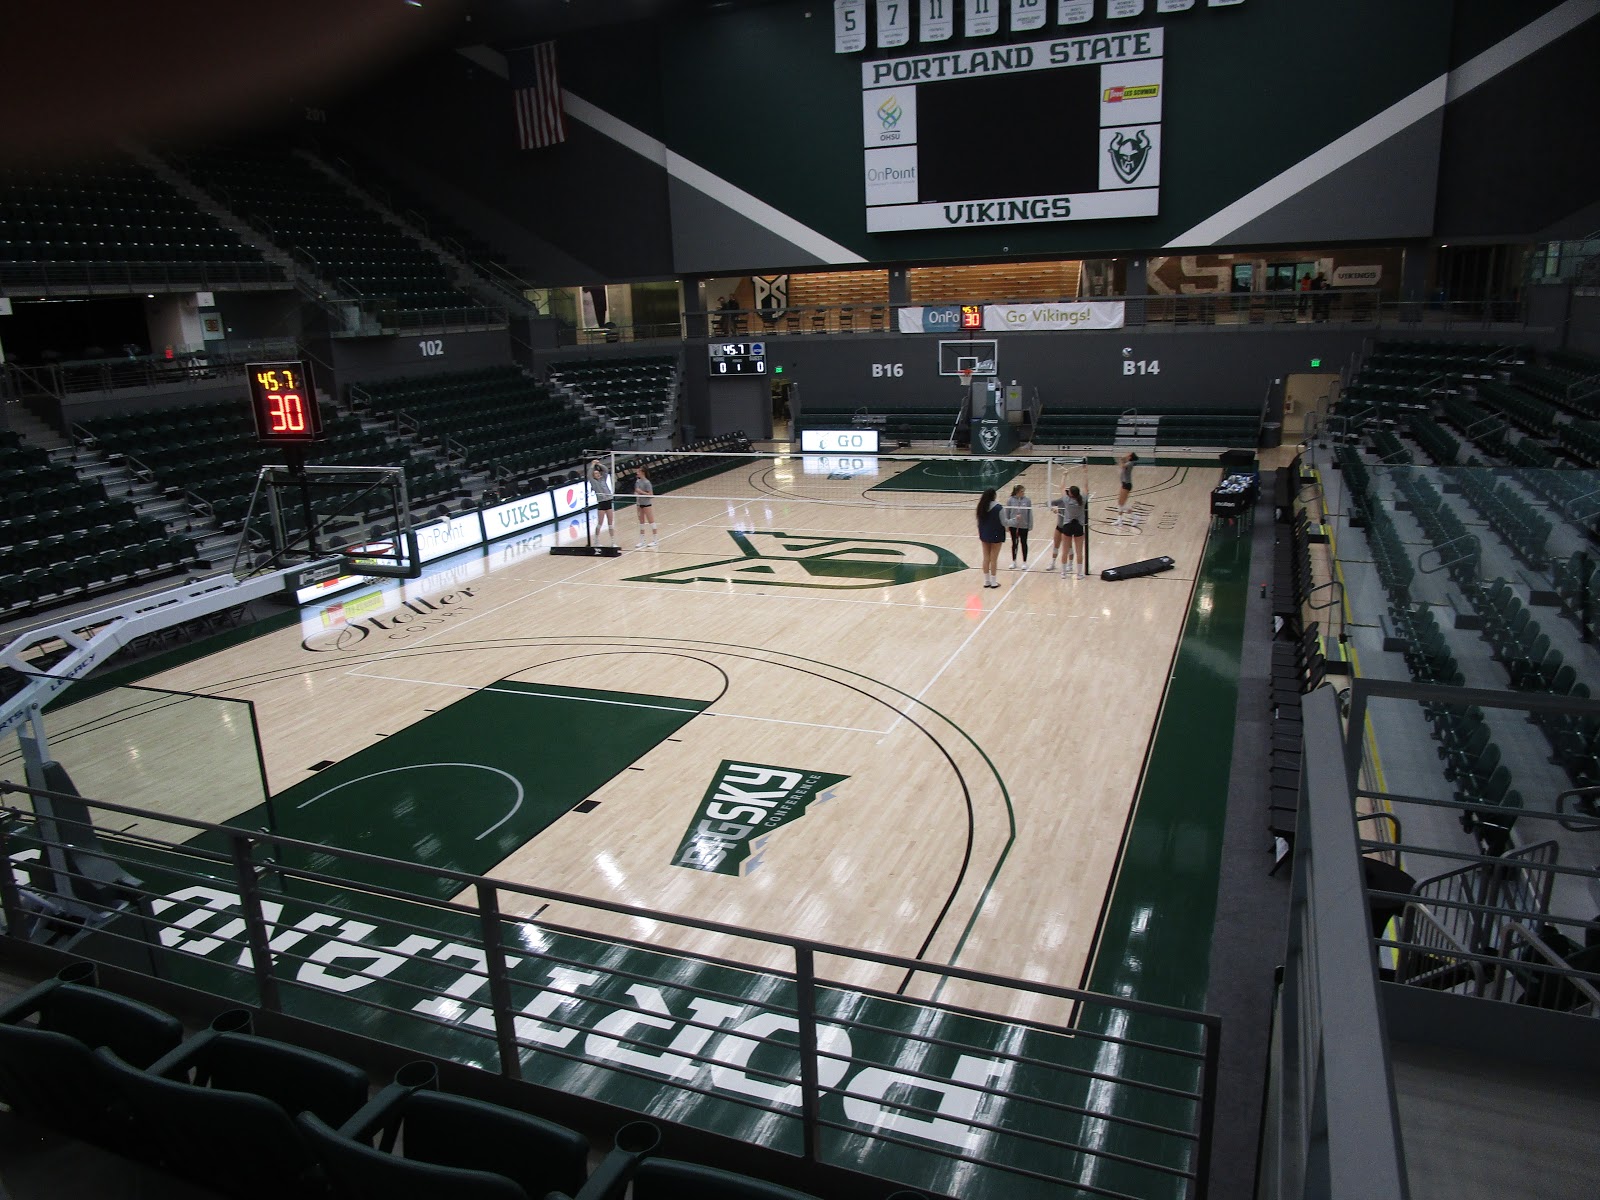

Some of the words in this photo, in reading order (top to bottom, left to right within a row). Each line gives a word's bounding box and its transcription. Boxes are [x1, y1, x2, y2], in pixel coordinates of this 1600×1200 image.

[887, 4, 898, 25] 7
[930, 0, 943, 19] 11
[845, 10, 855, 31] 5
[873, 46, 1034, 84] PORTLAND
[1049, 32, 1151, 65] STATE
[880, 133, 901, 141] OHSU
[867, 166, 915, 181] OnPoint
[943, 198, 1071, 224] VIKINGS
[1338, 272, 1377, 280] VIKINGS
[928, 311, 960, 324] OnPo
[964, 313, 980, 326] 30
[1006, 310, 1027, 323] Go
[1032, 308, 1091, 325] Vikings!
[419, 340, 444, 356] 102
[723, 344, 745, 355] 45.7
[720, 362, 727, 373] 0
[757, 361, 764, 372] 0
[872, 363, 904, 378] B16
[1123, 360, 1160, 376] B14
[257, 370, 294, 391] 45.7
[267, 394, 305, 431] 30
[838, 434, 863, 447] GO
[499, 501, 540, 528] VIKS
[388, 603, 474, 640] COURT
[50, 654, 95, 691] LEGACY
[764, 774, 822, 827] CONFERENCE
[151, 885, 1007, 1152] PORTLAND
